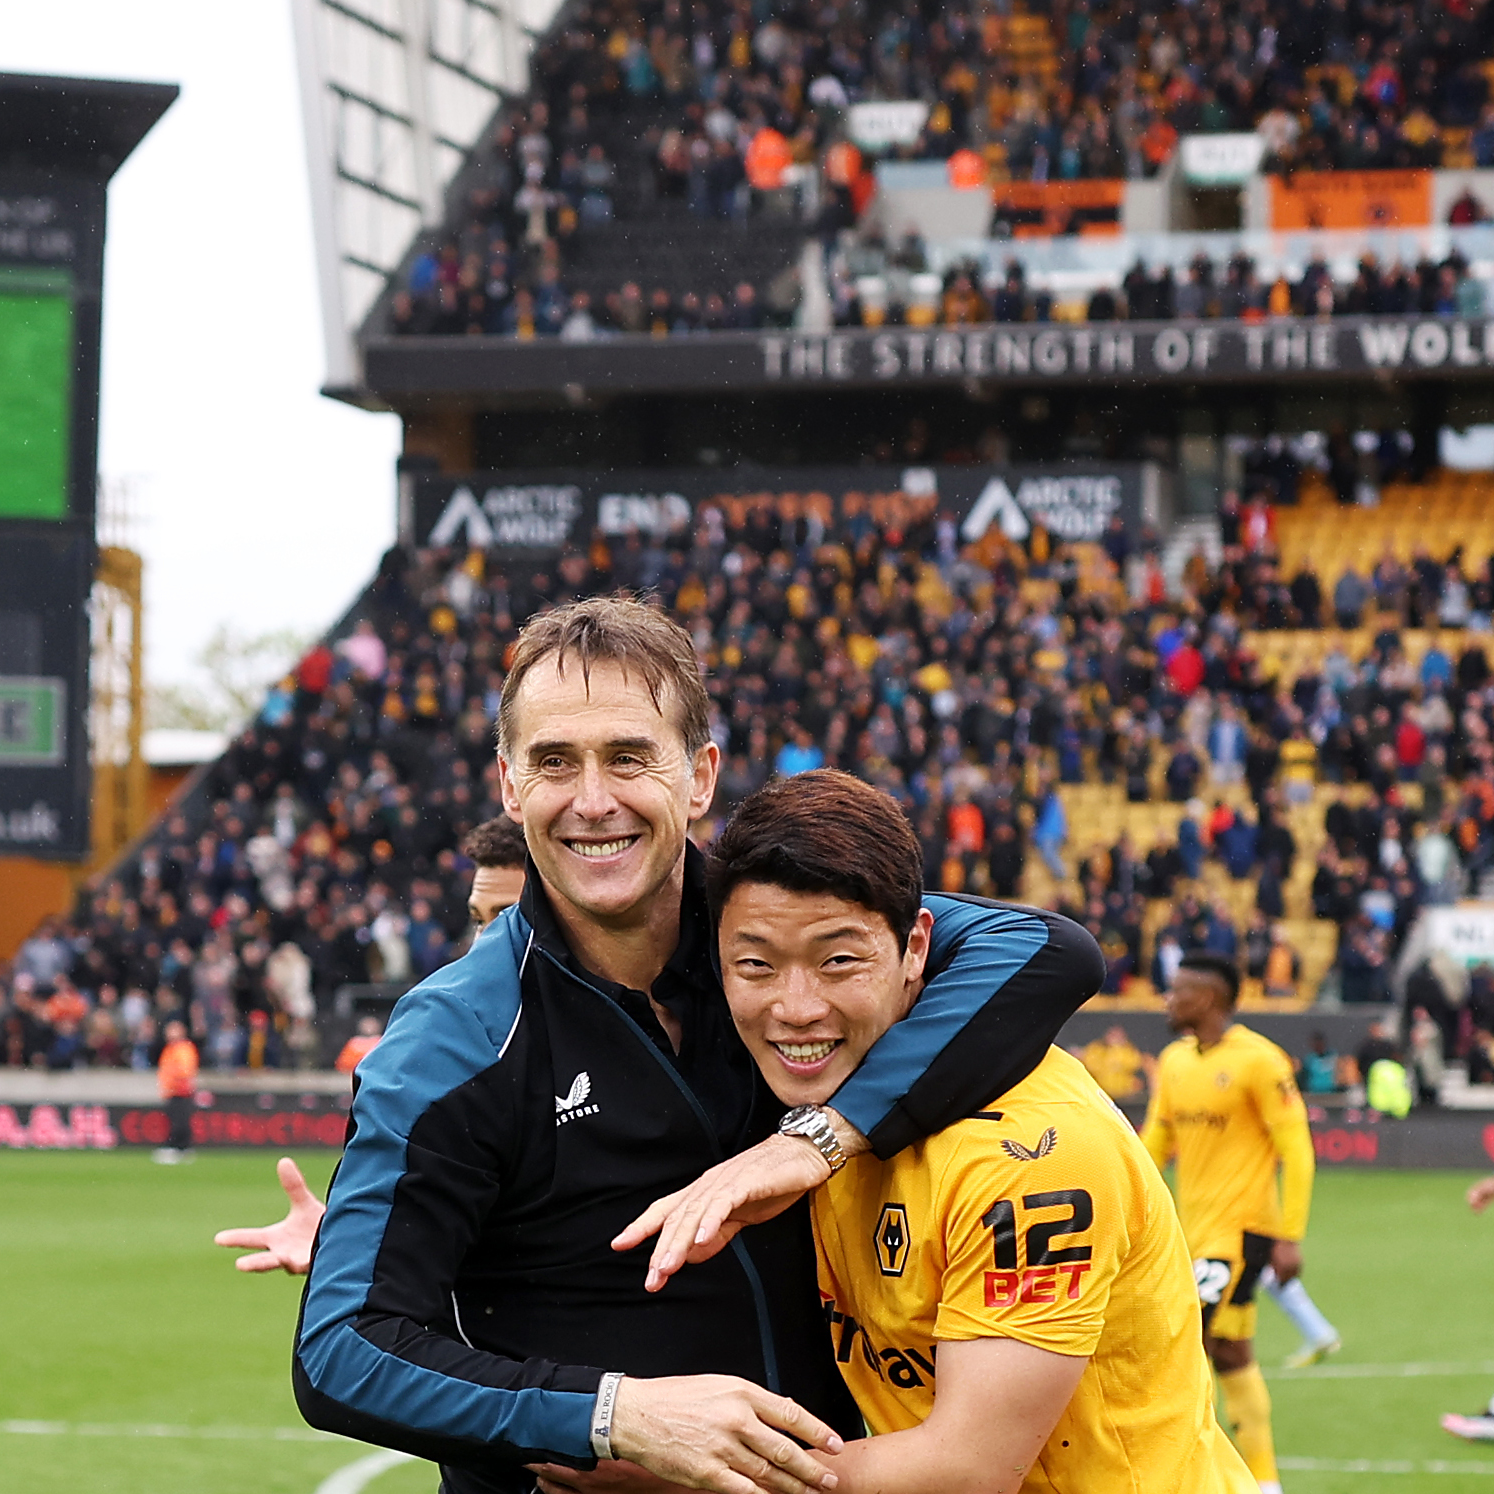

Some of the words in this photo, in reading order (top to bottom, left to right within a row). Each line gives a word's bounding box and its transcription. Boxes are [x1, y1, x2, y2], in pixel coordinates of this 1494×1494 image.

[761, 335, 854, 379] THE
[871, 329, 1136, 377] STRENGTH
[1153, 327, 1218, 374] OF
[1244, 322, 1341, 372] THE
[482, 484, 583, 516] ARCTIC
[1016, 475, 1123, 508] ARCTIC
[120, 1109, 350, 1146] COSTRUCTIO
[556, 1103, 600, 1127] STORE
[981, 1188, 1093, 1269] 12
[984, 1263, 1091, 1308] BET
[601, 1409, 609, 1420] EL
